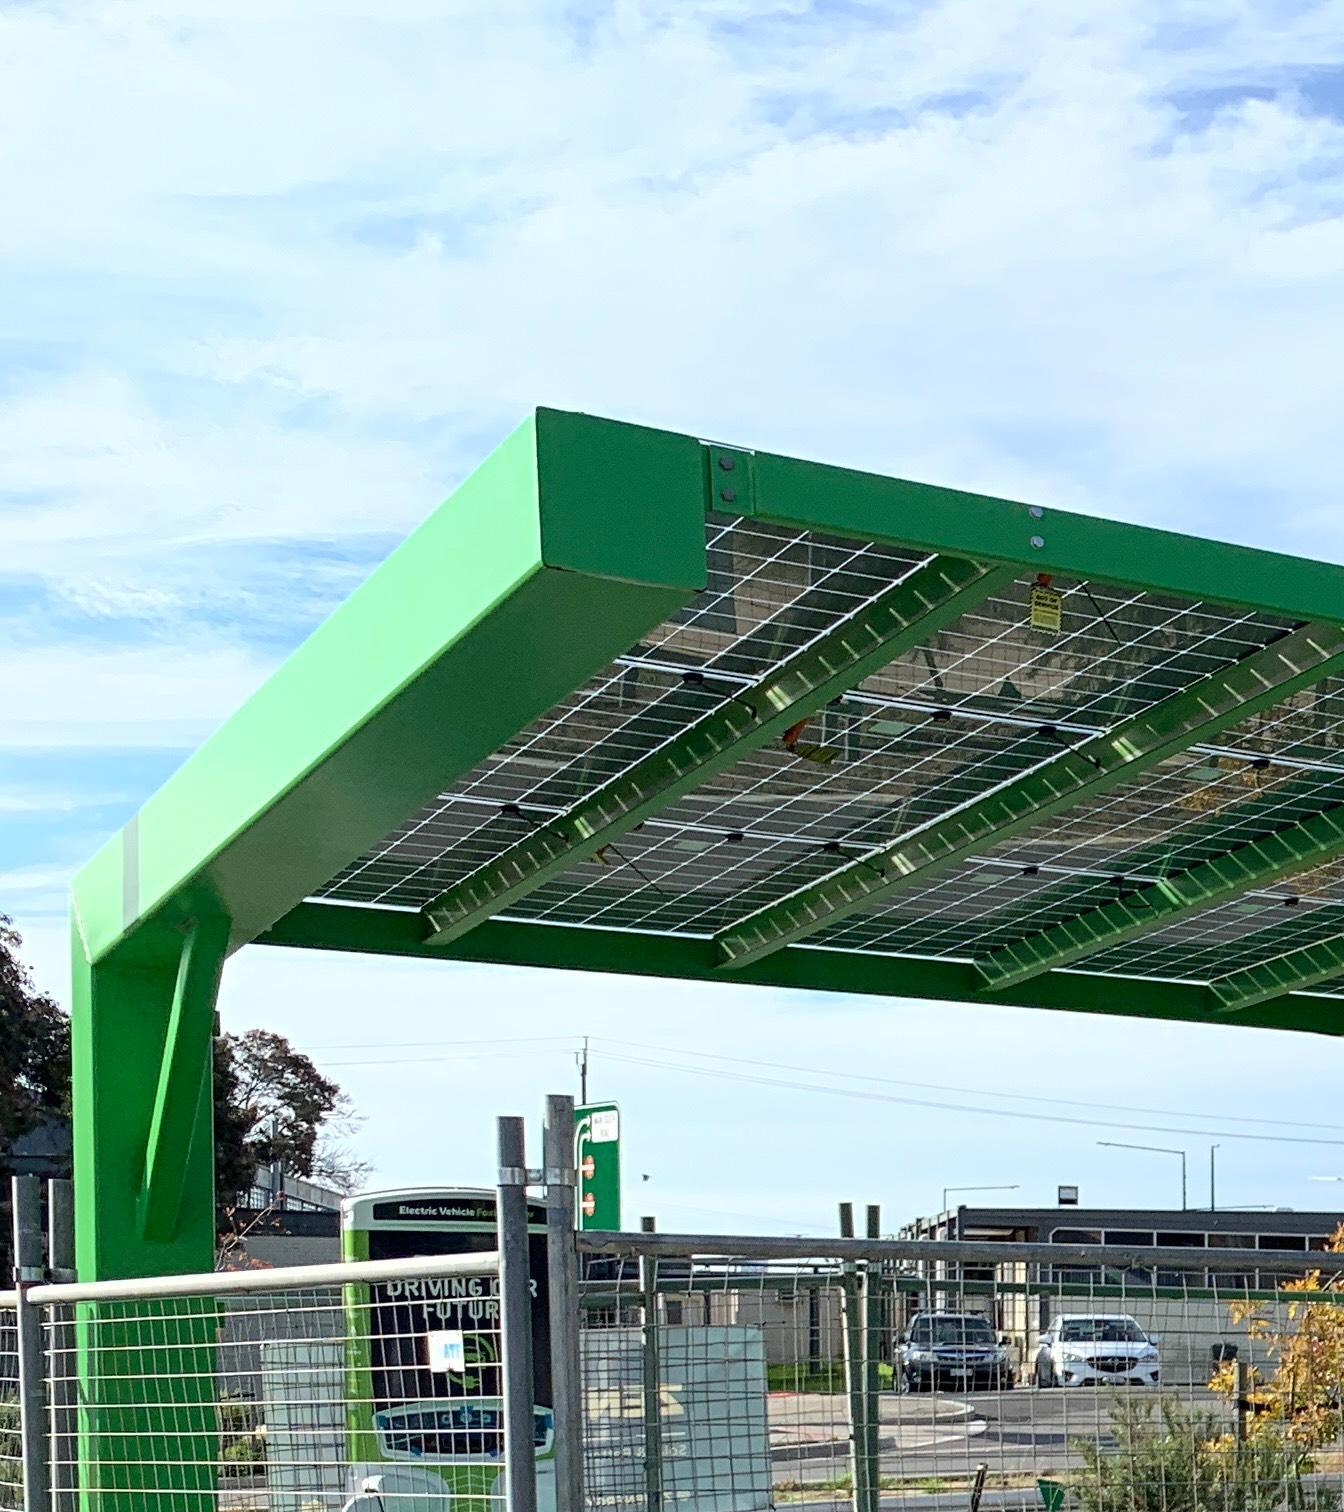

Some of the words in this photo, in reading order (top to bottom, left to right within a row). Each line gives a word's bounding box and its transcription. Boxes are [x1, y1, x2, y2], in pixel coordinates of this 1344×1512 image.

[399, 1205, 438, 1216] Electric
[440, 1207, 475, 1217] Vehicle
[386, 1278, 482, 1297] DRIVING
[423, 1301, 500, 1320] FUTUR
